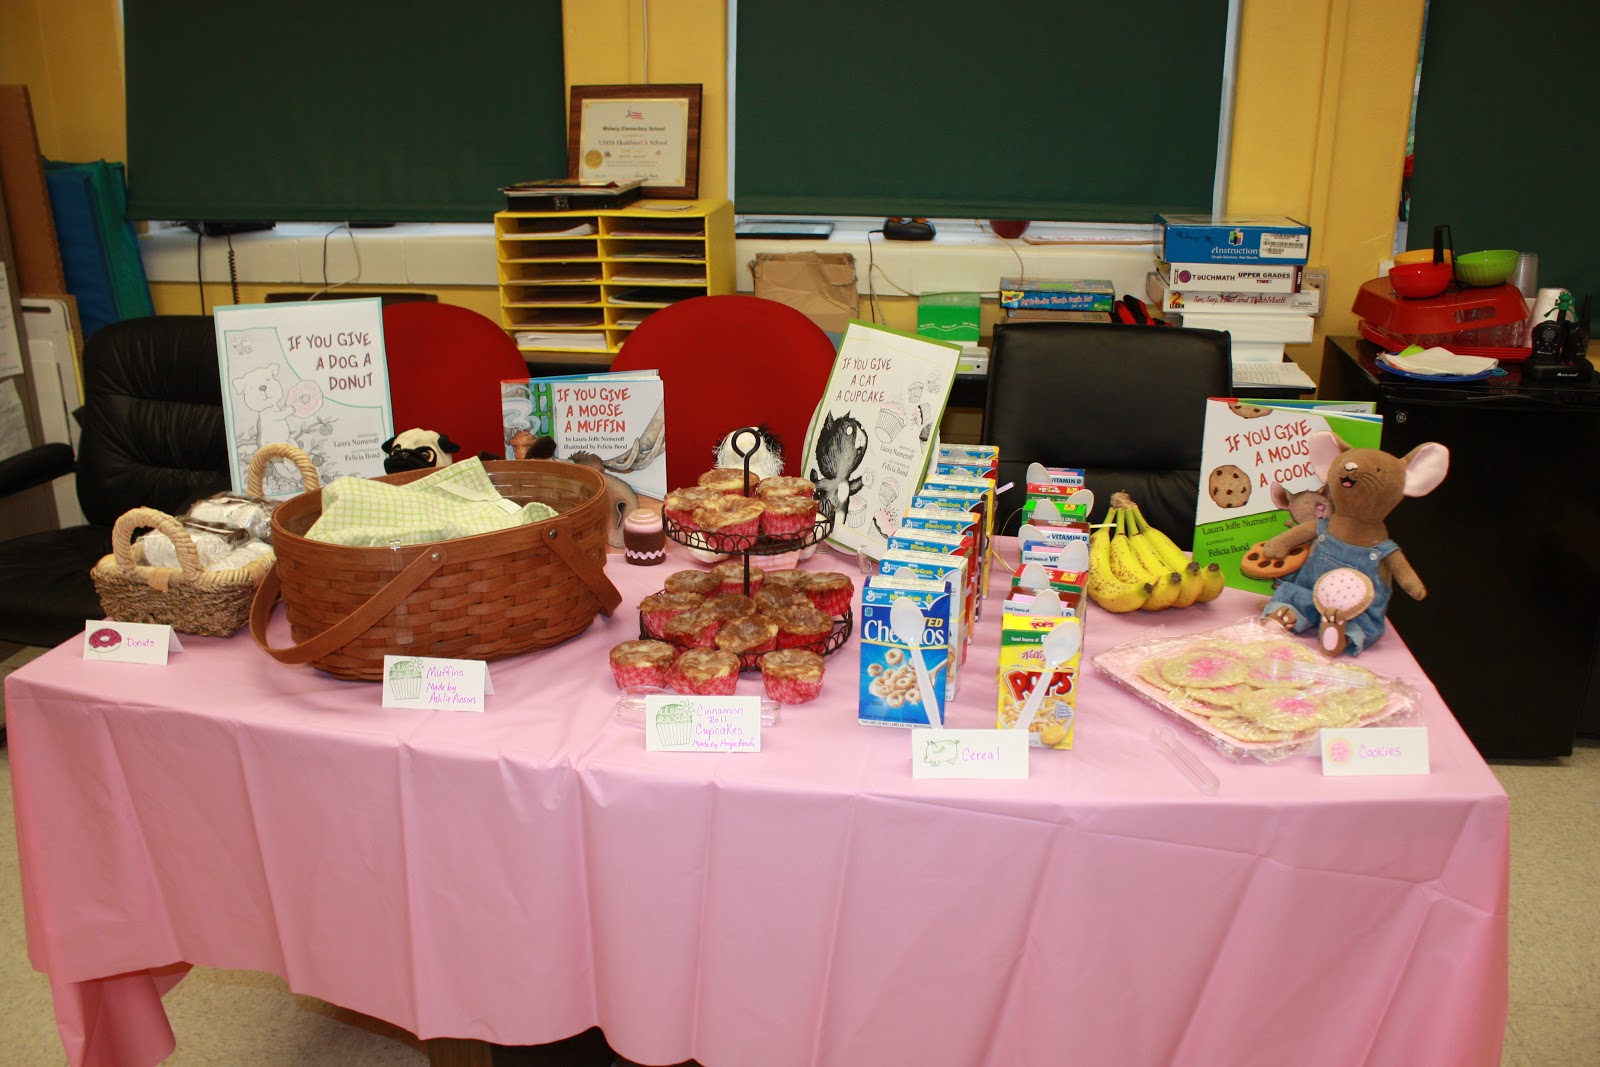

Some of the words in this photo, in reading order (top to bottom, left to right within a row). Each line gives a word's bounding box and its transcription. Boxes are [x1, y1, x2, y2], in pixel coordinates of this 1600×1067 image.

[1211, 246, 1258, 255] eInstruction
[288, 335, 301, 351] IF
[306, 333, 332, 349] YOU
[337, 332, 371, 347] GIVE
[316, 356, 324, 371] A
[329, 354, 358, 369] DOG
[363, 353, 372, 367] A
[842, 358, 852, 370] IF
[853, 358, 869, 370] YOU
[870, 358, 891, 370] GIVE
[329, 372, 373, 391] DONUT
[851, 375, 857, 386] A
[859, 375, 876, 387] CAT
[557, 388, 570, 402] IF
[573, 388, 597, 401] YOU
[600, 388, 630, 402] GIVE
[836, 390, 842, 402] A
[844, 390, 885, 402] CUPCAKE
[566, 406, 574, 418] A
[579, 404, 623, 418] MOOSE
[564, 420, 572, 433] A
[578, 419, 626, 433] MUFFIN
[352, 437, 379, 445] Numeroff
[1225, 433, 1240, 453] IF
[1243, 426, 1271, 448] YOU
[1274, 419, 1312, 441] GIVE
[880, 444, 893, 454] Laura
[1255, 451, 1264, 467] A
[1268, 440, 1310, 464] MOUS
[882, 462, 896, 473] Felicia
[896, 467, 909, 477] Bond
[1260, 473, 1268, 488] A
[1274, 462, 1315, 484] COOK
[1202, 524, 1224, 535] Laura
[1225, 521, 1242, 532] Joffe
[1242, 514, 1278, 528] Numeroff
[1208, 547, 1230, 557] Felicia
[1230, 543, 1249, 553] Bond
[127, 638, 154, 647] Donuts
[426, 666, 463, 678] Muffins
[426, 682, 445, 692] Made
[447, 682, 456, 693] by
[453, 693, 476, 704] Pinson
[697, 705, 743, 716] Cinnamon
[707, 716, 727, 724] Roll
[720, 739, 738, 749] Hope
[962, 746, 1000, 761] Cereal
